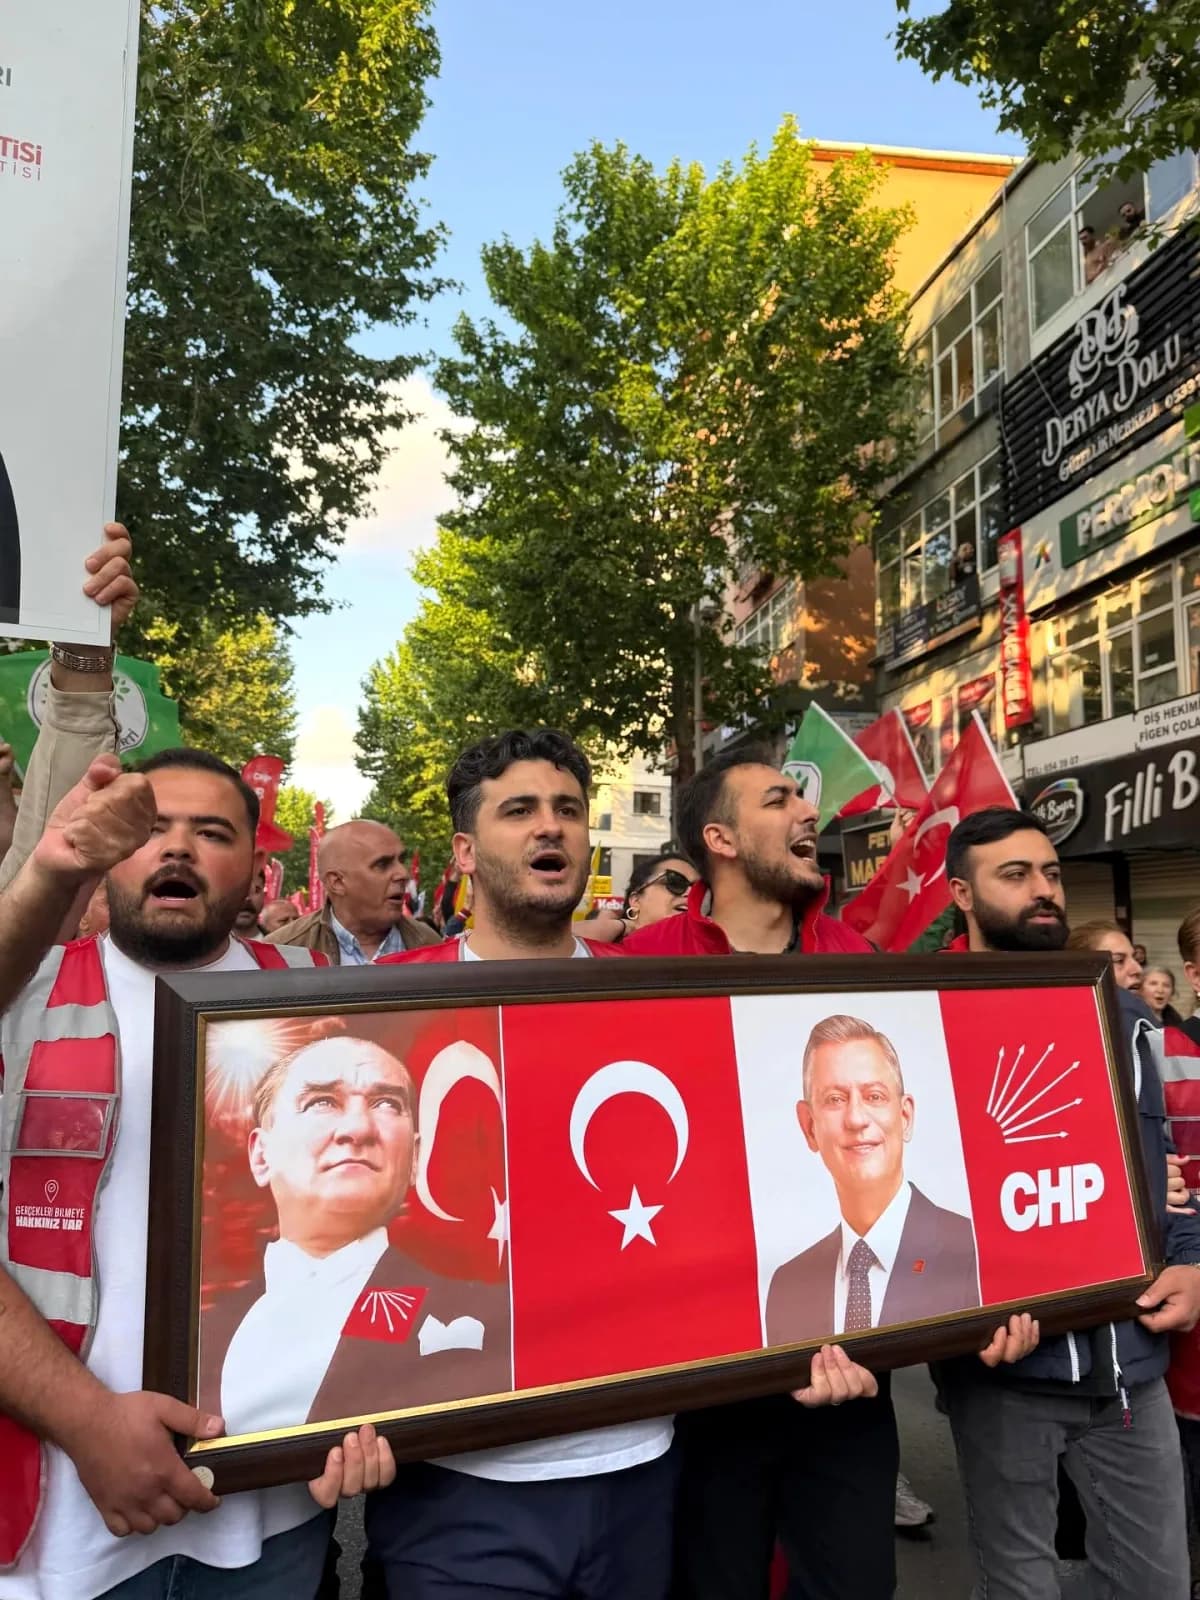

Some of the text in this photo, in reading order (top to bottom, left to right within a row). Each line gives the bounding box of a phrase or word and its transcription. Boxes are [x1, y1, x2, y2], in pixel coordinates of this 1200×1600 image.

[1042, 333, 1180, 466] DERYA DOLU
[1139, 725, 1169, 742] FİGEN
[1105, 763, 1163, 842] Filli
[62, 1218, 83, 1231] VAR
[1000, 1162, 1105, 1232] CHP
